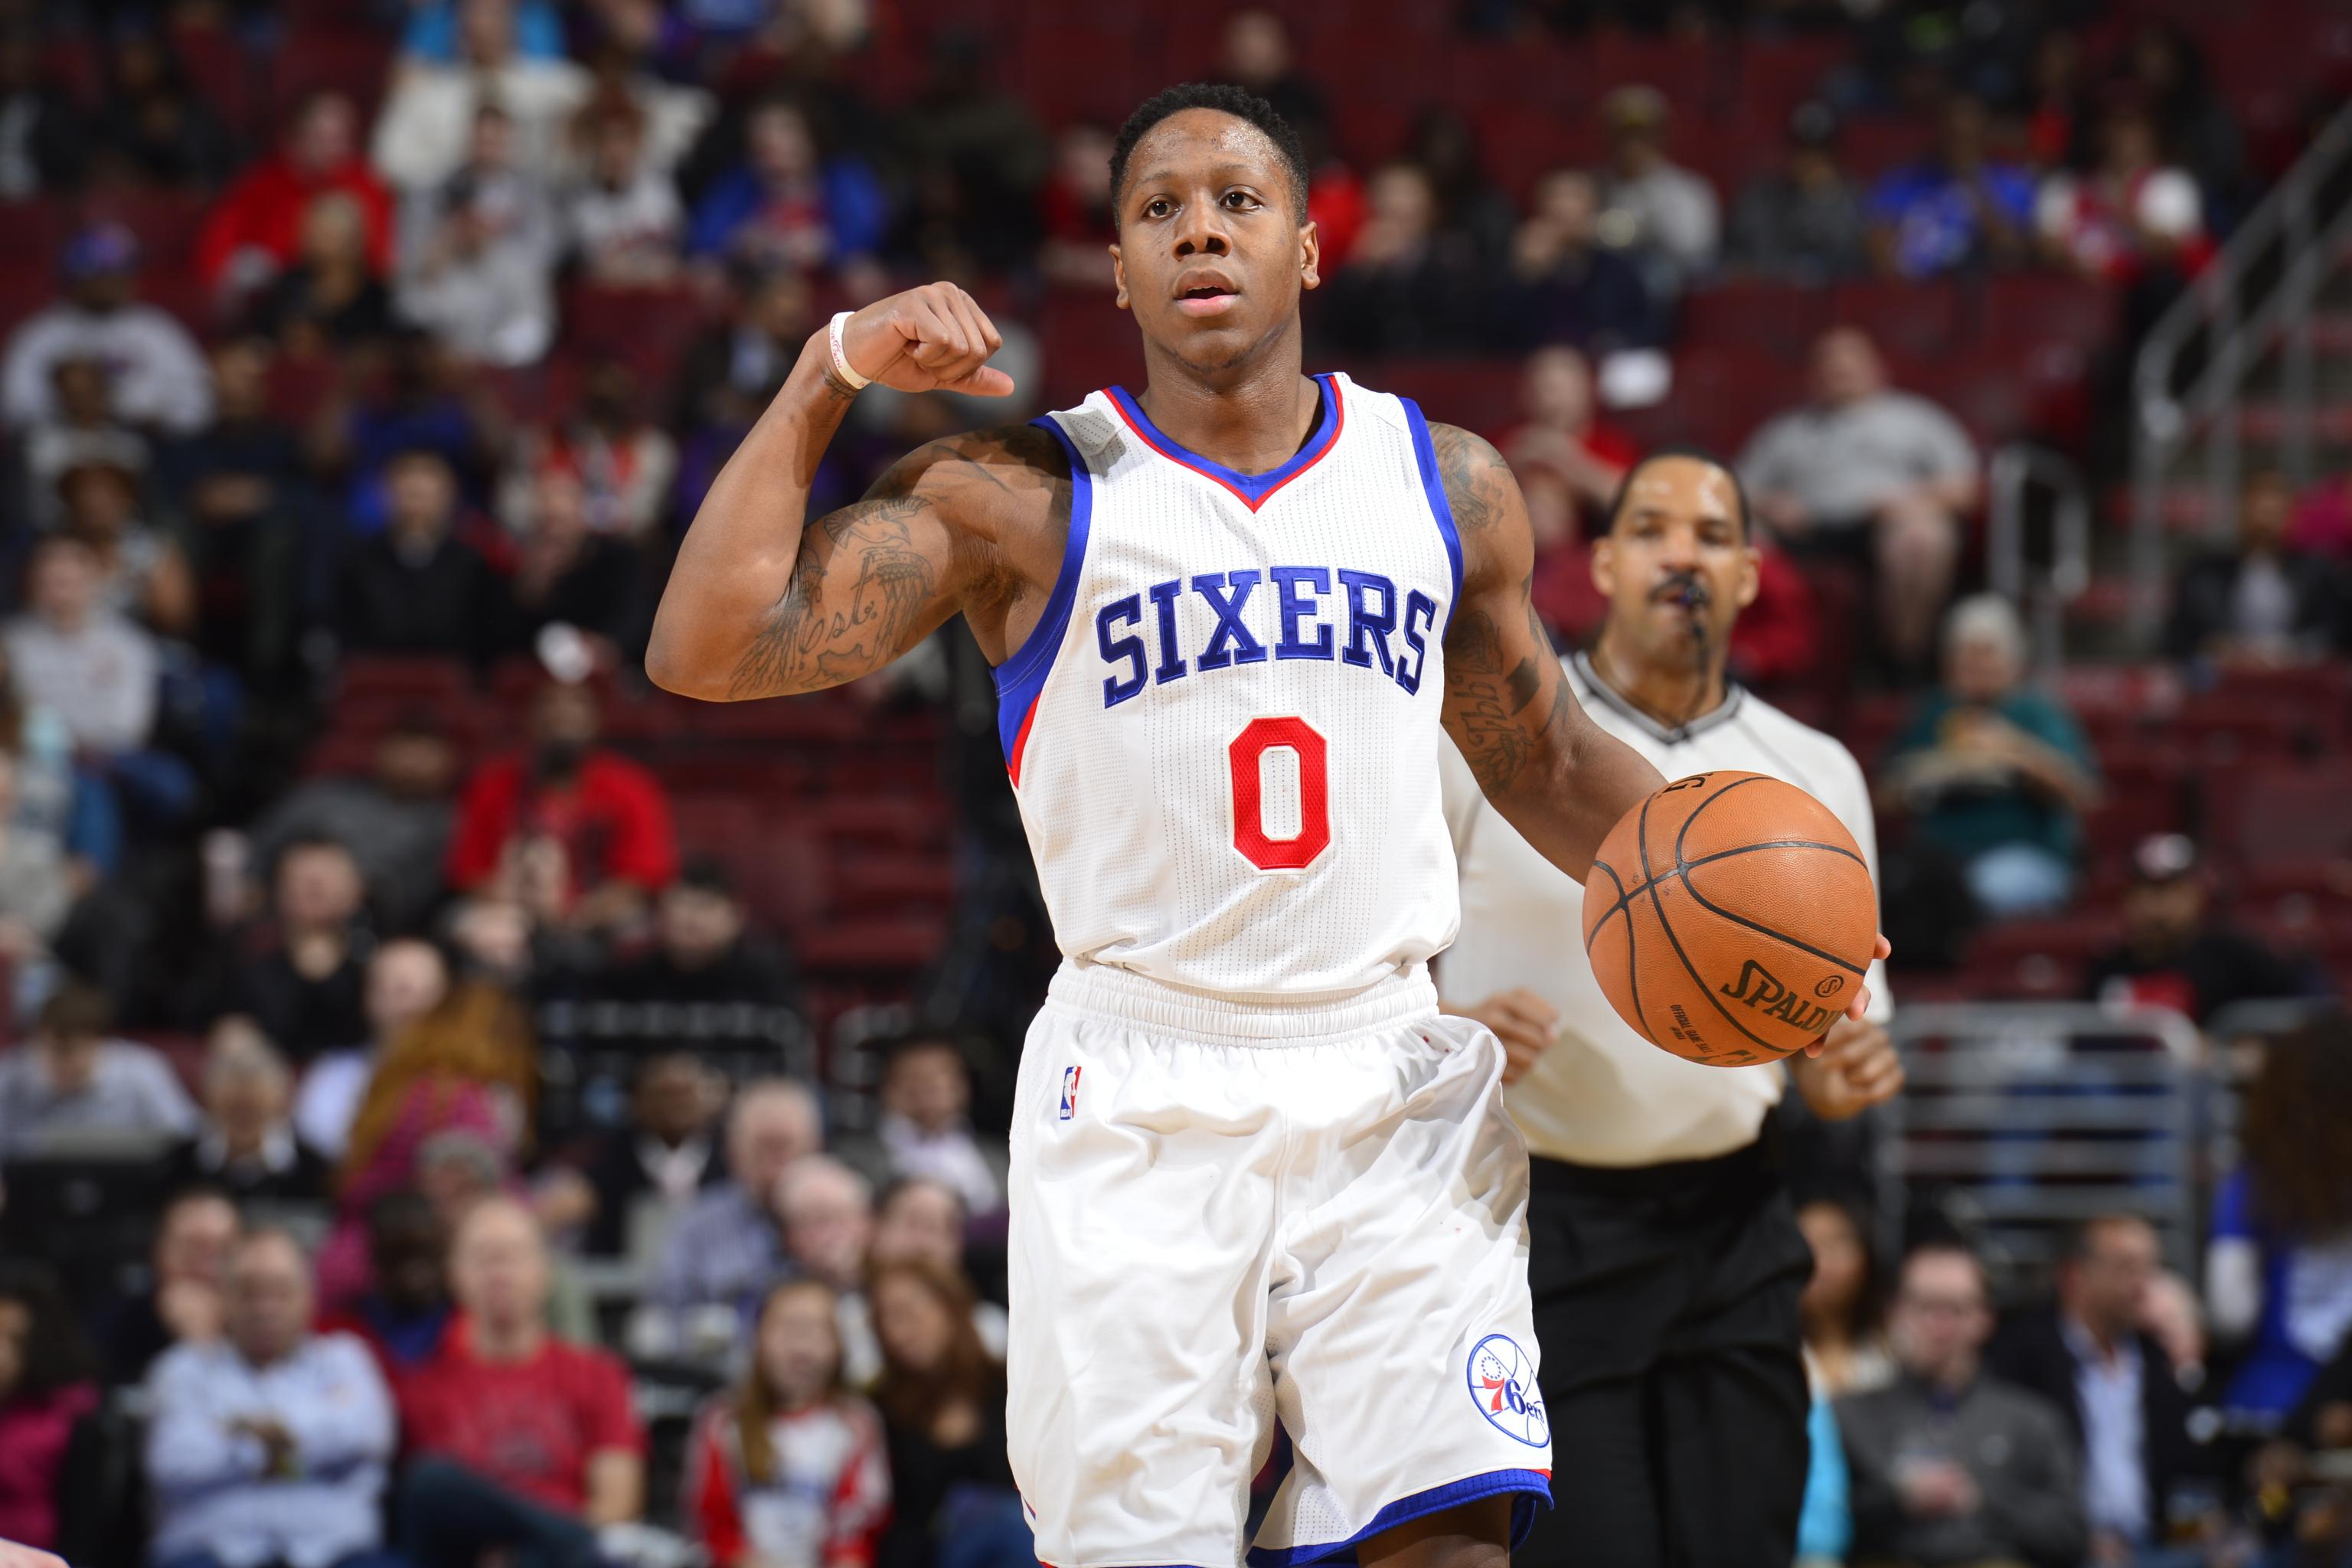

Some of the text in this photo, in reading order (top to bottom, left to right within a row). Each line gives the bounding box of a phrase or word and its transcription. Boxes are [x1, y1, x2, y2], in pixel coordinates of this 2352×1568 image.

[1096, 566, 1436, 708] SIXERS
[1229, 715, 1331, 870] 0
[1670, 1004, 1692, 1029] OFFICIAL
[1684, 1030, 1704, 1043] GAME
[1482, 1375, 1545, 1424] 76ers
